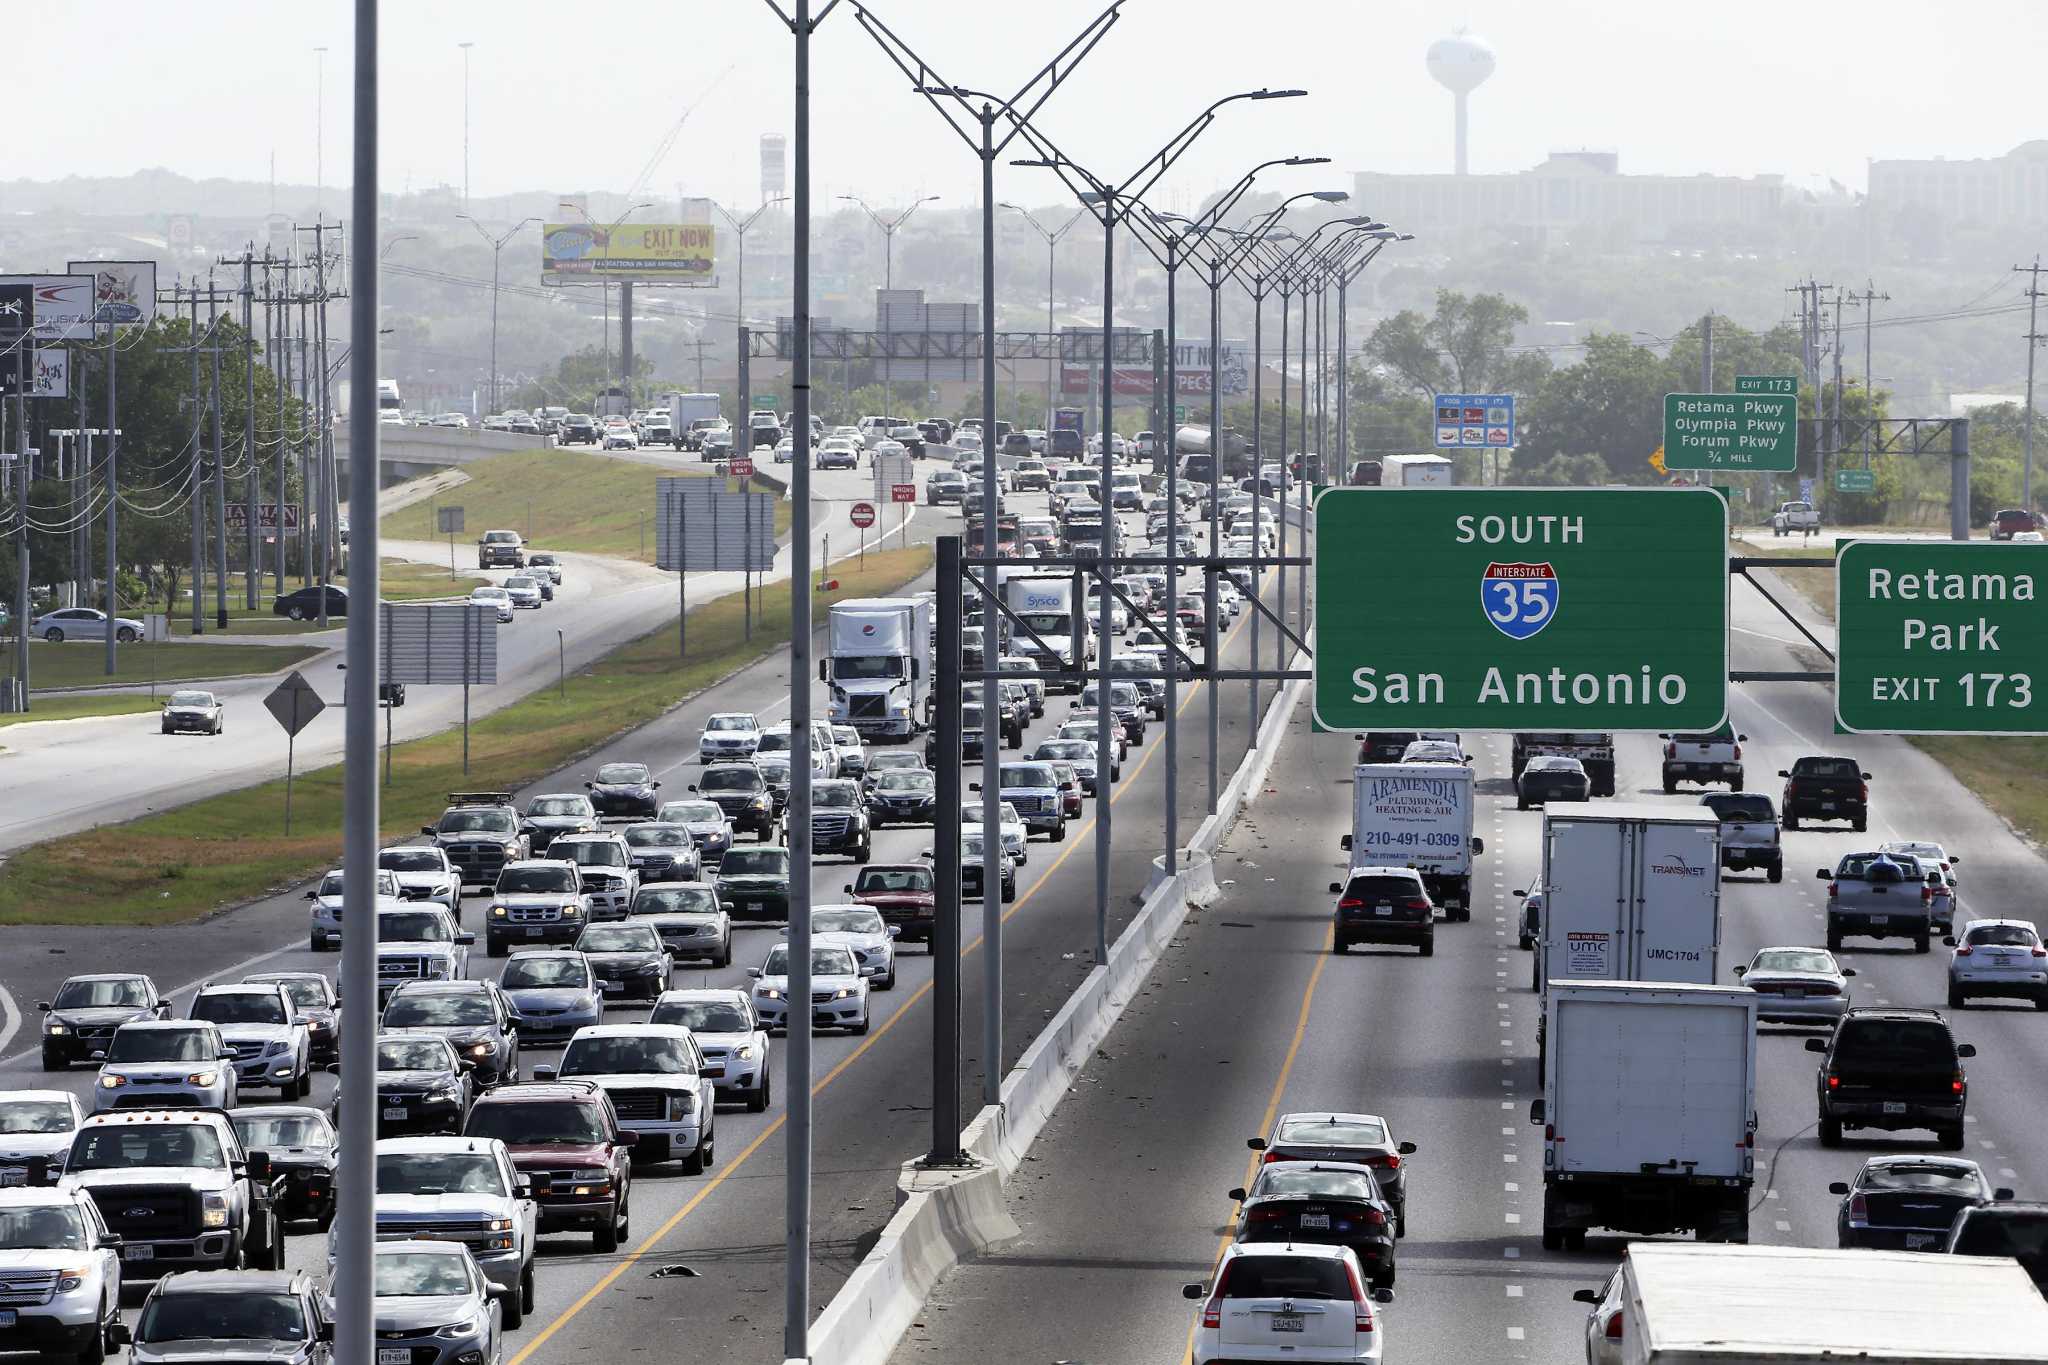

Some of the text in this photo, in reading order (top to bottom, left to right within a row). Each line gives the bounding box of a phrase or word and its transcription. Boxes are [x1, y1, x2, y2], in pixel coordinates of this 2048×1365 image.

[644, 229, 710, 249] EXIT NOW
[1741, 380, 1791, 391] EXIT 173
[1678, 401, 1783, 416] Retama Pkwy
[1675, 418, 1785, 434] Olympia Pkwy
[1682, 435, 1778, 450] Forum Pkwy
[1730, 454, 1752, 462] MILE
[1456, 515, 1583, 543] SOUTH
[1493, 567, 1546, 577] INTERSTATE
[1869, 568, 2034, 600] Retama
[1028, 596, 1060, 608] Sysco
[1491, 582, 1550, 623] 35
[1904, 618, 2000, 650] Park
[1352, 665, 1687, 704] San Antonio
[1873, 672, 2032, 708] EXIT 173
[1369, 778, 1458, 808] ARAMENDIA
[1388, 797, 1442, 805] PLUMBING
[1376, 806, 1422, 814] HEATING
[1434, 807, 1452, 815] AIR
[1366, 832, 1460, 846] 210-491-0309
[1647, 949, 1699, 961] UMC1704
